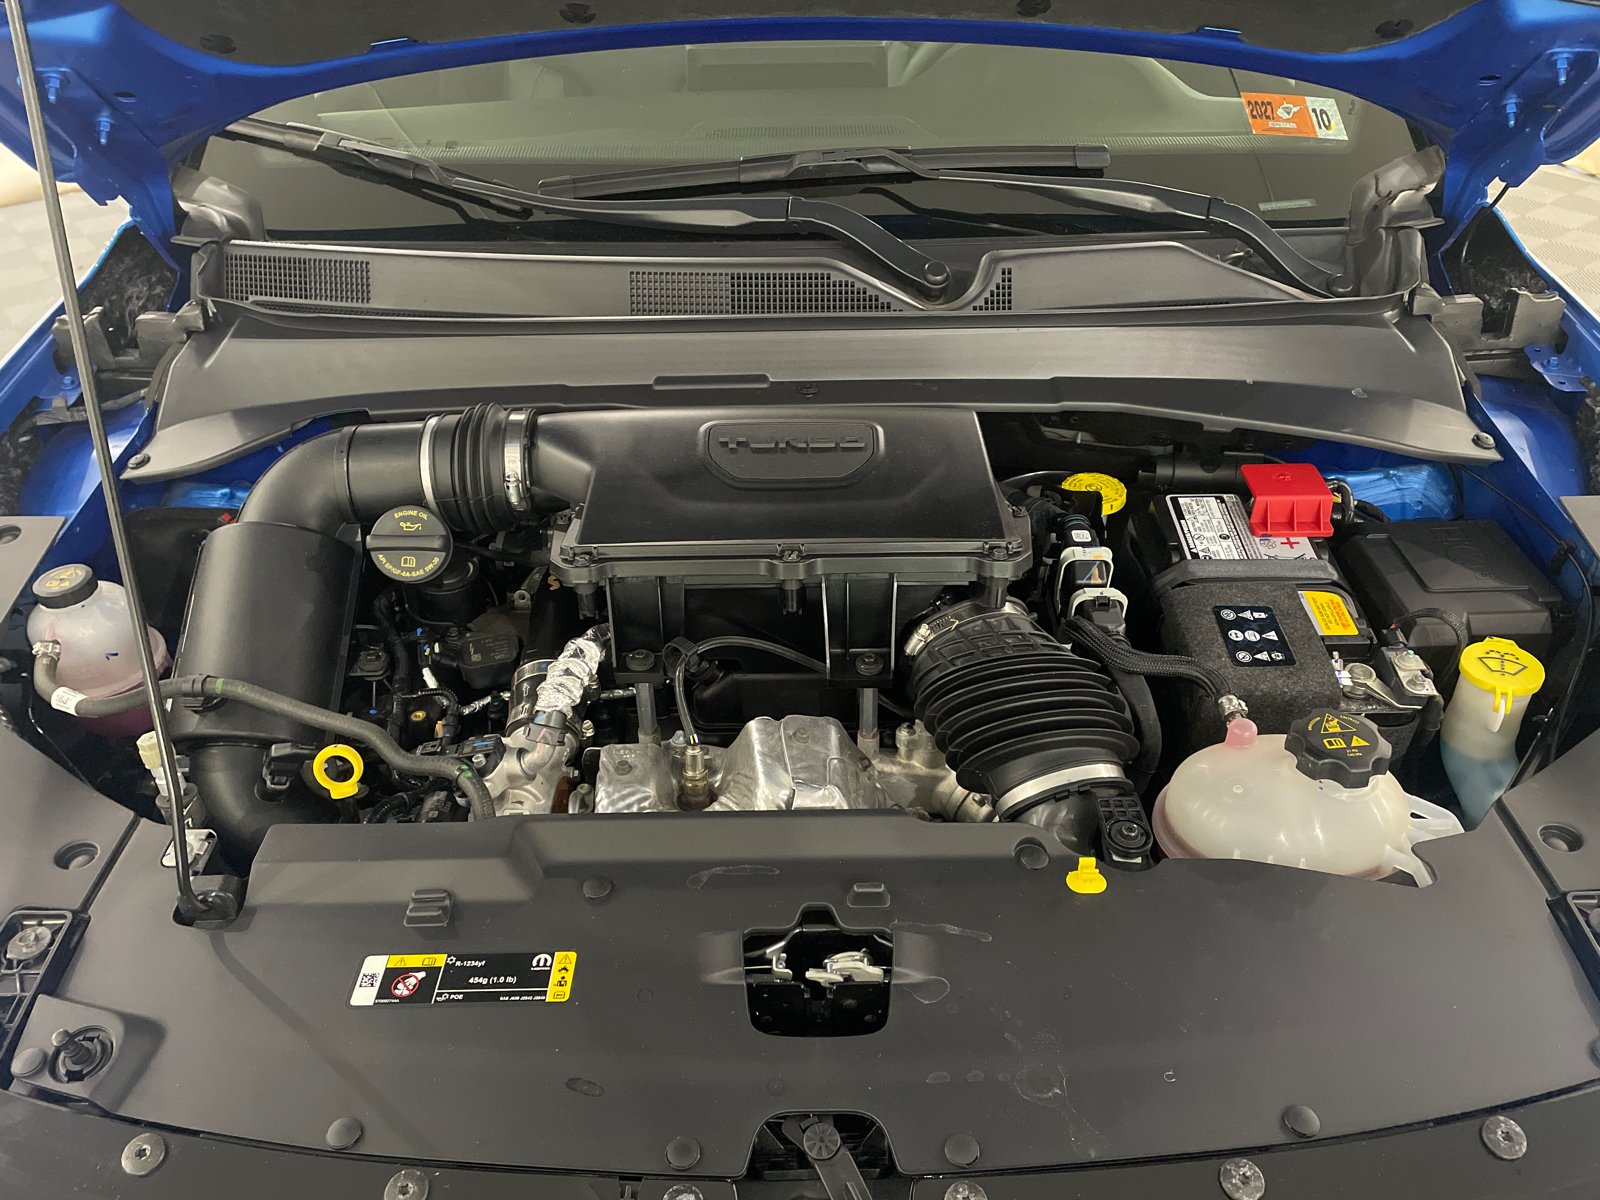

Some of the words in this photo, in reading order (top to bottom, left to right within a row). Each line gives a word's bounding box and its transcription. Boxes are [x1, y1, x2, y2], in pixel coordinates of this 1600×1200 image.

[1247, 100, 1274, 120] 2027
[1311, 108, 1332, 130] 10
[718, 436, 867, 452] TURBO
[394, 510, 418, 519] ENGINE
[418, 512, 428, 520] OIL
[468, 976, 488, 984] 454g
[489, 976, 504, 984] (1.0
[506, 976, 517, 984] lb)
